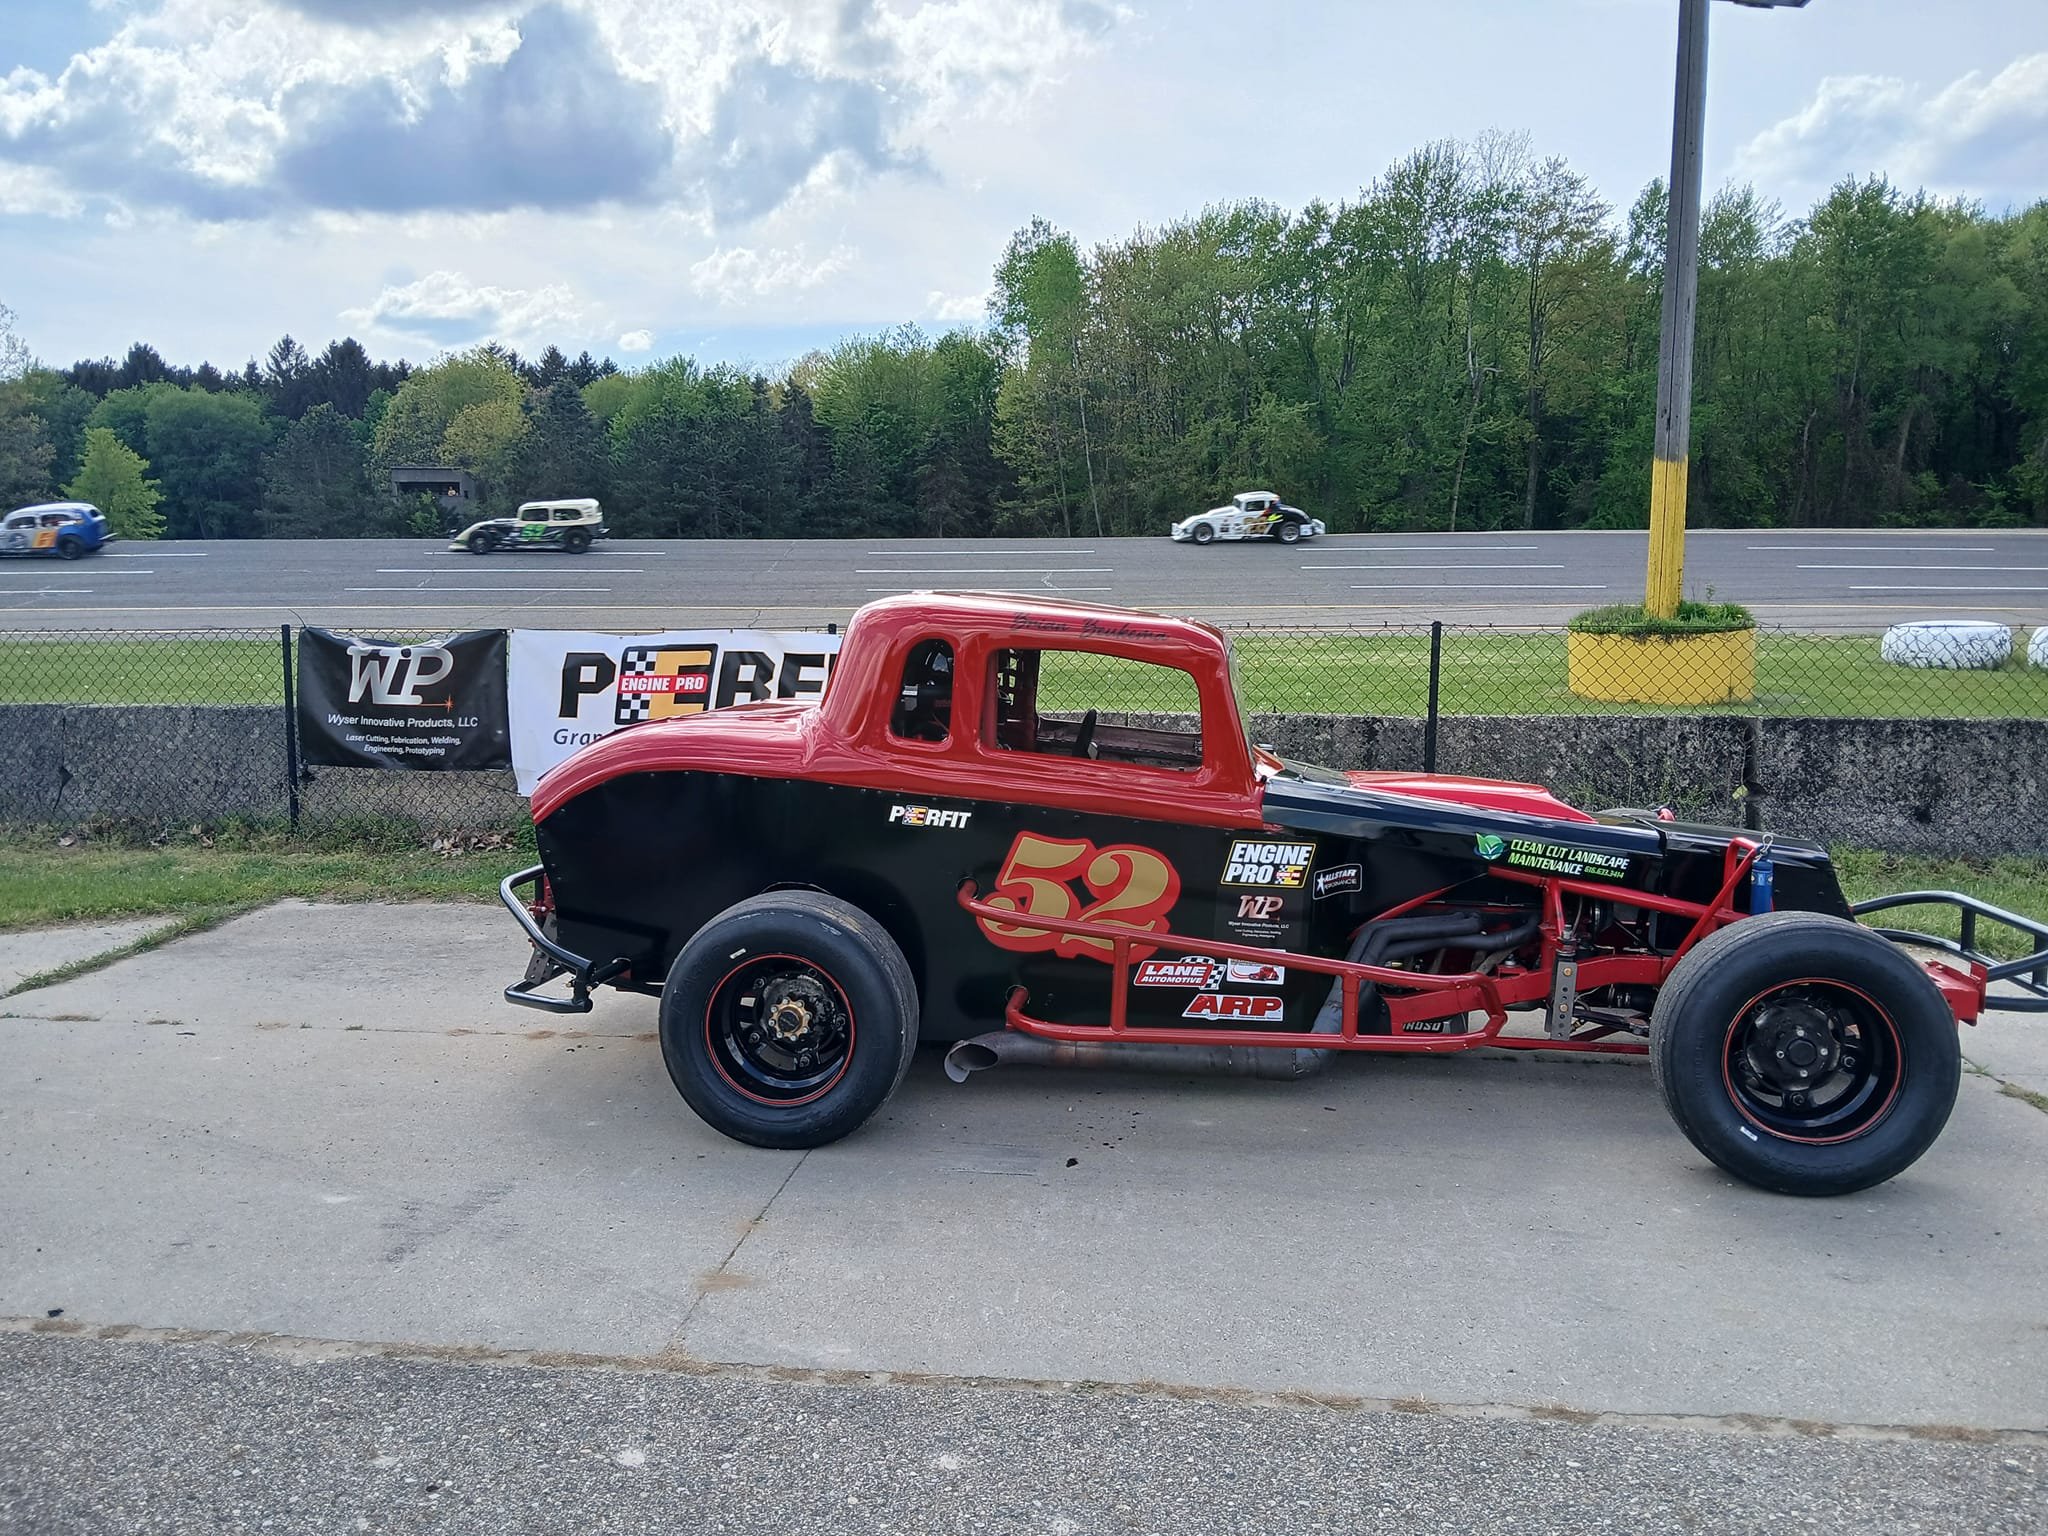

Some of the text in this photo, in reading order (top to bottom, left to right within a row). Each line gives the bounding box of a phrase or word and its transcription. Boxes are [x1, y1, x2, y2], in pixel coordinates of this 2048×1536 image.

[558, 643, 838, 724] PERF
[621, 676, 704, 692] ENGINE PRO
[328, 714, 479, 729] Wyser Innovative Products, LLC
[345, 733, 365, 742] Laser
[888, 805, 972, 829] PERFIT
[1231, 843, 1312, 865] ENGINE
[1508, 852, 1583, 875] MAINTENANCE
[1510, 839, 1630, 870] CLEAN CUT LANDSCAPE
[1225, 863, 1274, 884] PRO
[978, 833, 1178, 958] 52
[1141, 976, 1204, 984] AUTOMOTIVE
[1145, 965, 1207, 977] LANE
[1187, 994, 1282, 1017] ARP
